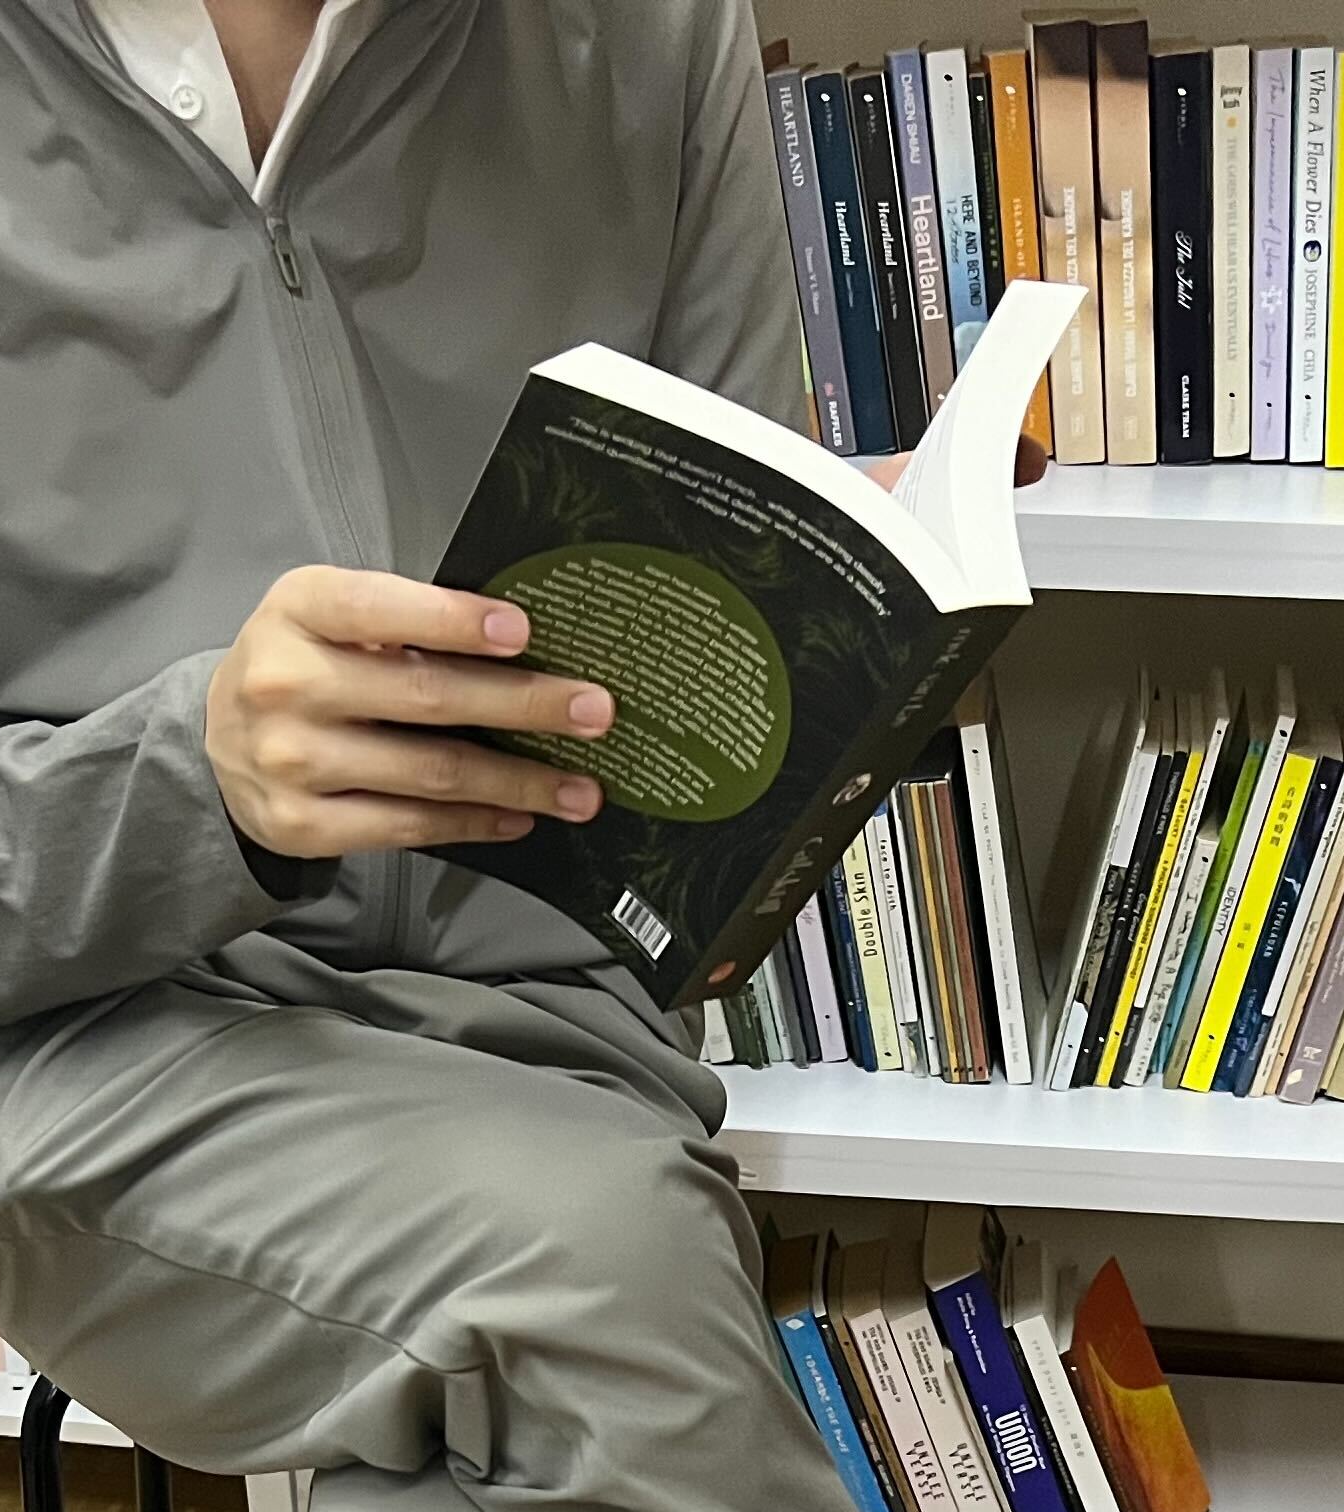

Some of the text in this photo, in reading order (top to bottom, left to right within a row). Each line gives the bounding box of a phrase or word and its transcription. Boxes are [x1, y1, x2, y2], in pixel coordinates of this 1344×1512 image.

[776, 85, 805, 188] HEARTLAND
[900, 73, 921, 164] DAREN SHIAU
[1303, 69, 1325, 233] When A Flower Dies
[832, 200, 855, 266] Heartland
[876, 201, 897, 266] Heartland
[908, 194, 946, 321] Heartland
[959, 194, 983, 306] HERE AND BEYOND
[1174, 230, 1192, 264] The
[1301, 268, 1318, 382] JOSEPHINE CHIA
[827, 400, 843, 446] RAFFLES
[1180, 375, 1189, 438] CLAIRE THAM
[848, 871, 879, 957] Double Skin
[904, 1446, 933, 1499] VERSE
[912, 1439, 945, 1501] UNFREE
[947, 1449, 975, 1501] VERSE
[955, 1442, 986, 1502] UNFREE
[992, 1409, 1039, 1475] UNION
